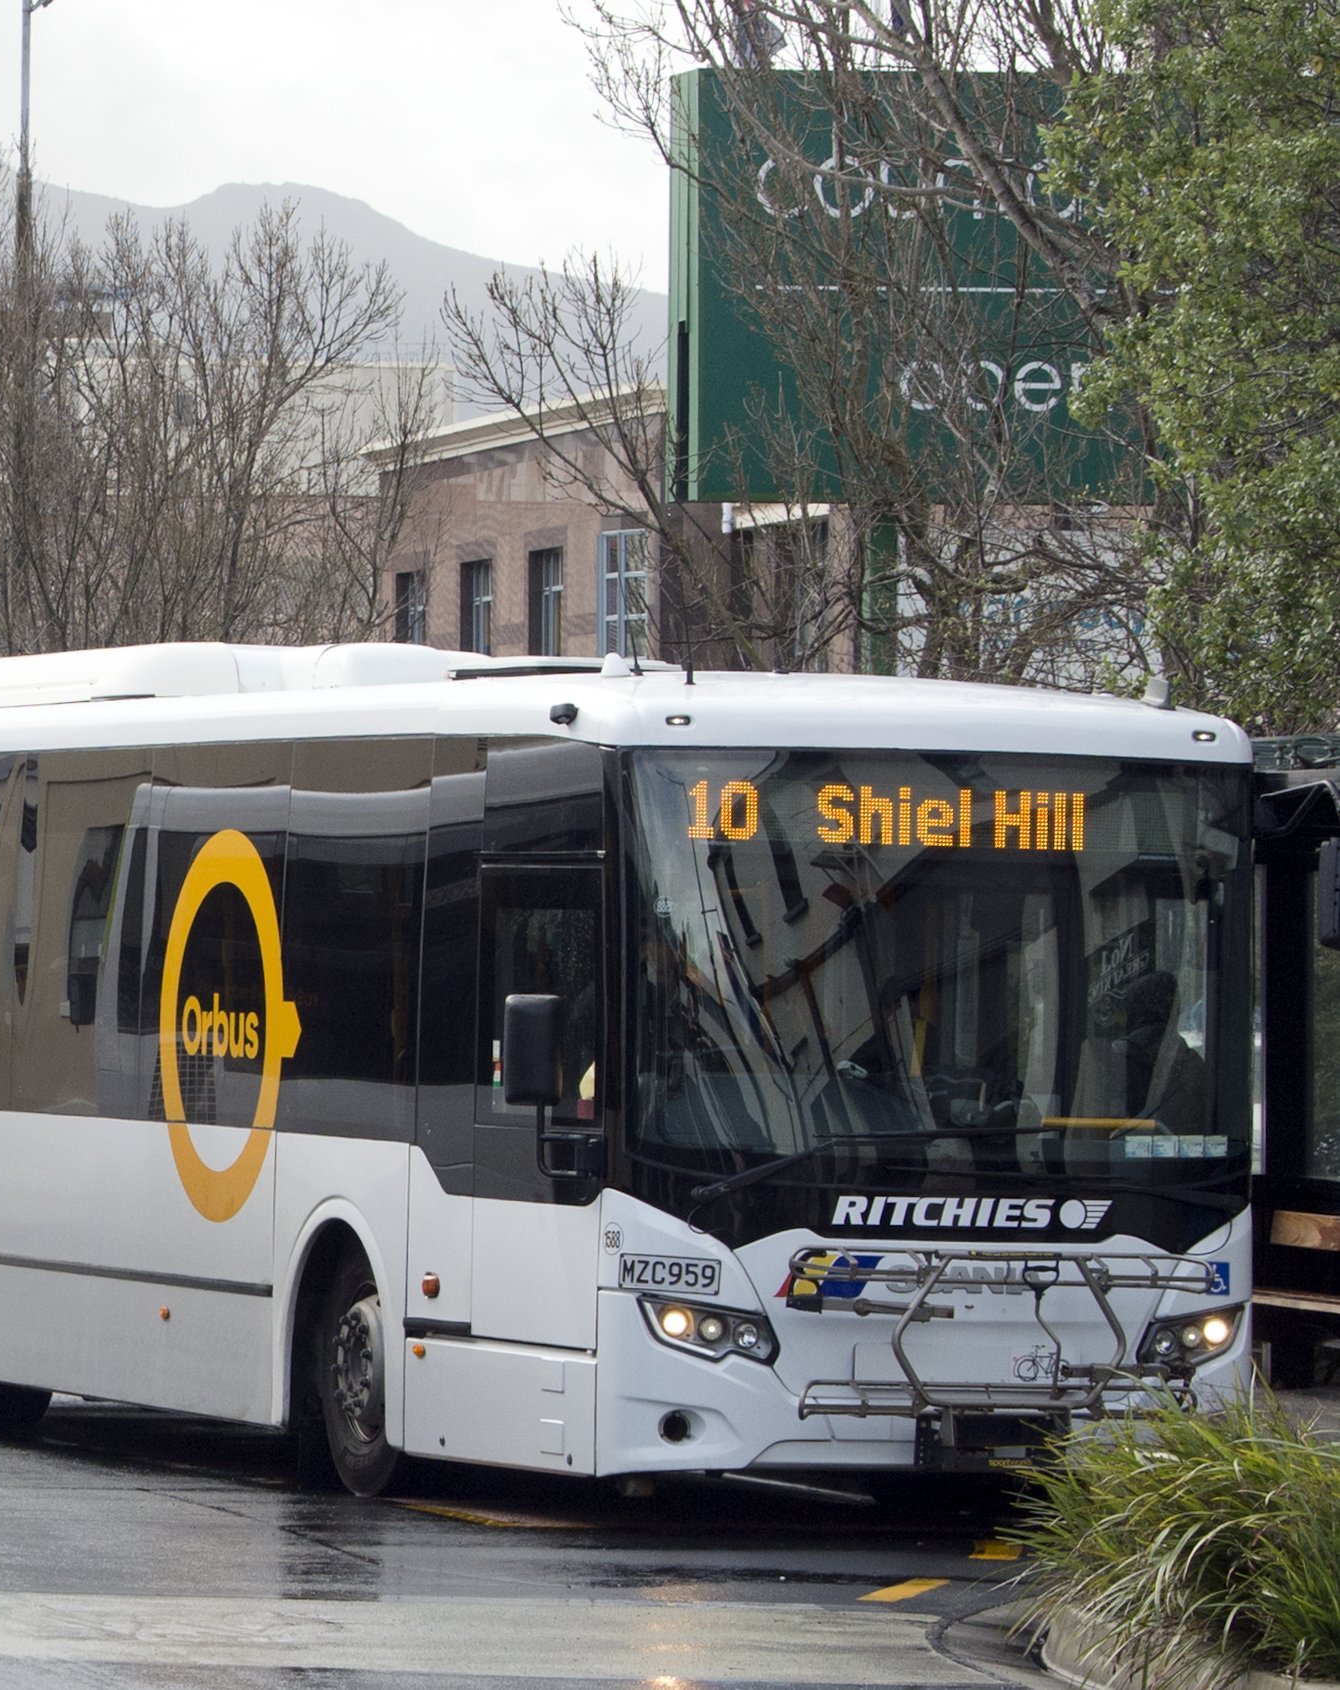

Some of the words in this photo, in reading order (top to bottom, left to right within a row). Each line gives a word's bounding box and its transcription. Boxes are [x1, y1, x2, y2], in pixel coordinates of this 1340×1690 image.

[687, 780, 758, 841] 10
[817, 784, 971, 848] Shiel
[994, 789, 1085, 852] Hill
[182, 992, 259, 1059] Orbus
[831, 1195, 1056, 1228] RITCHIES
[604, 1230, 620, 1249] 1588
[622, 1259, 716, 1288] MZC959
